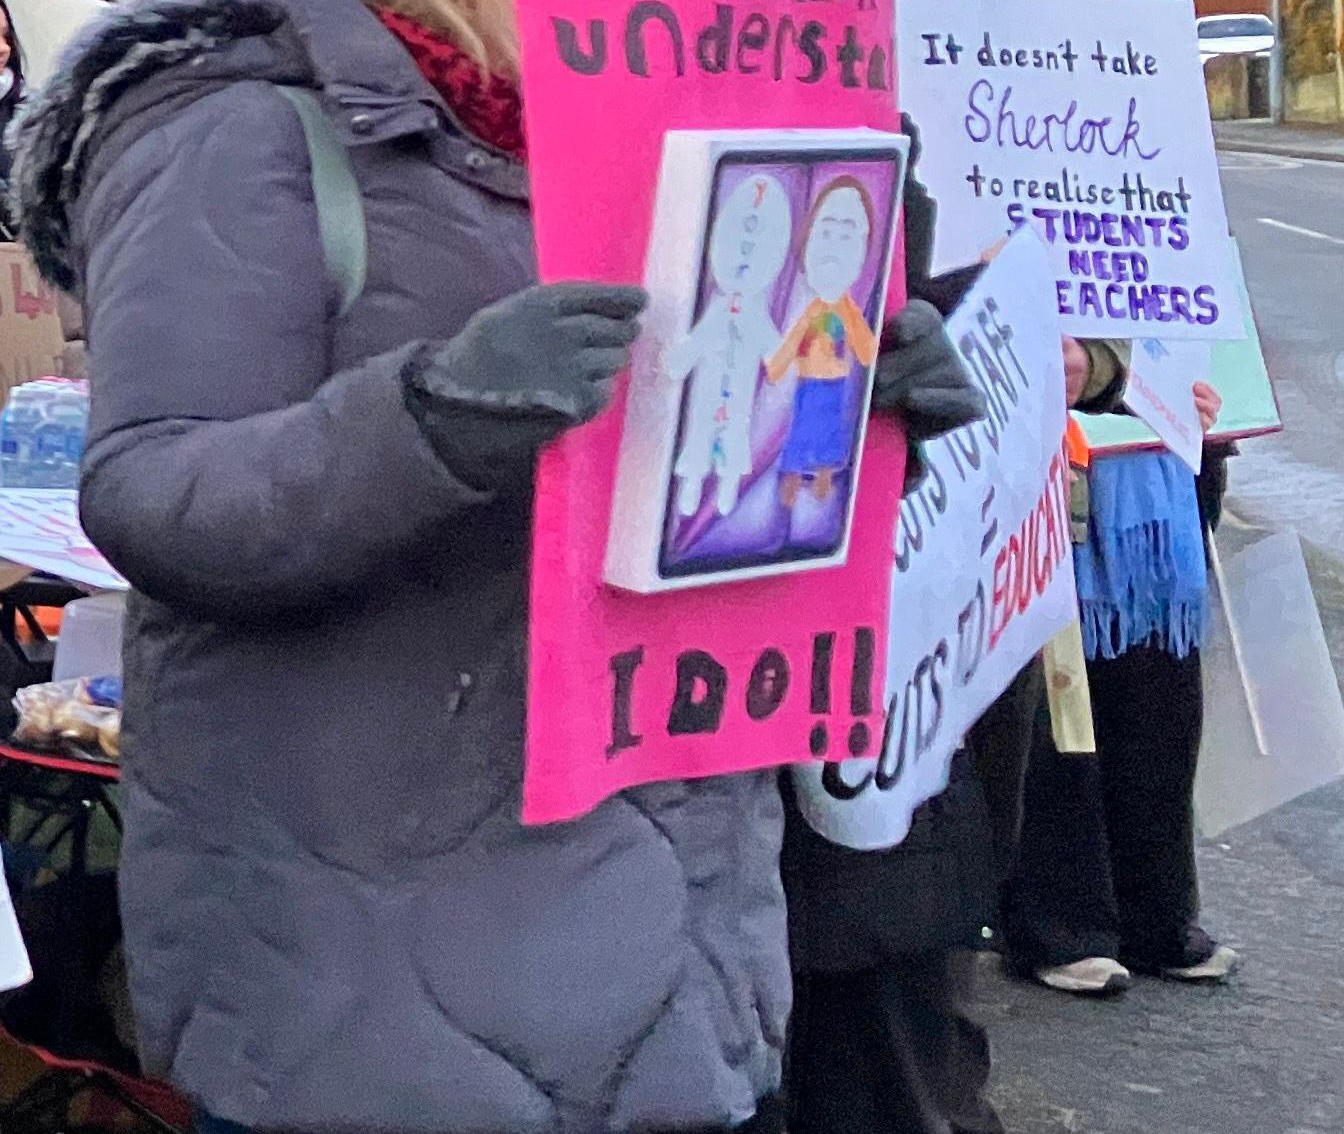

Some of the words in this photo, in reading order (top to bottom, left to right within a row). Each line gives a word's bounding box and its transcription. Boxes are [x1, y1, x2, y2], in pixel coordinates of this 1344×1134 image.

[551, 0, 894, 91] understa
[921, 33, 963, 65] It
[977, 31, 1078, 72] doesn't
[1091, 40, 1158, 75] take
[965, 79, 1161, 160] Sherlock
[966, 164, 1003, 197] to
[1014, 168, 1115, 205] realise
[1118, 172, 1192, 213] that
[1007, 204, 1189, 251] STUDENTS
[1068, 249, 1150, 283] NEED
[1056, 280, 1219, 325] EACHERS
[604, 646, 645, 761] I
